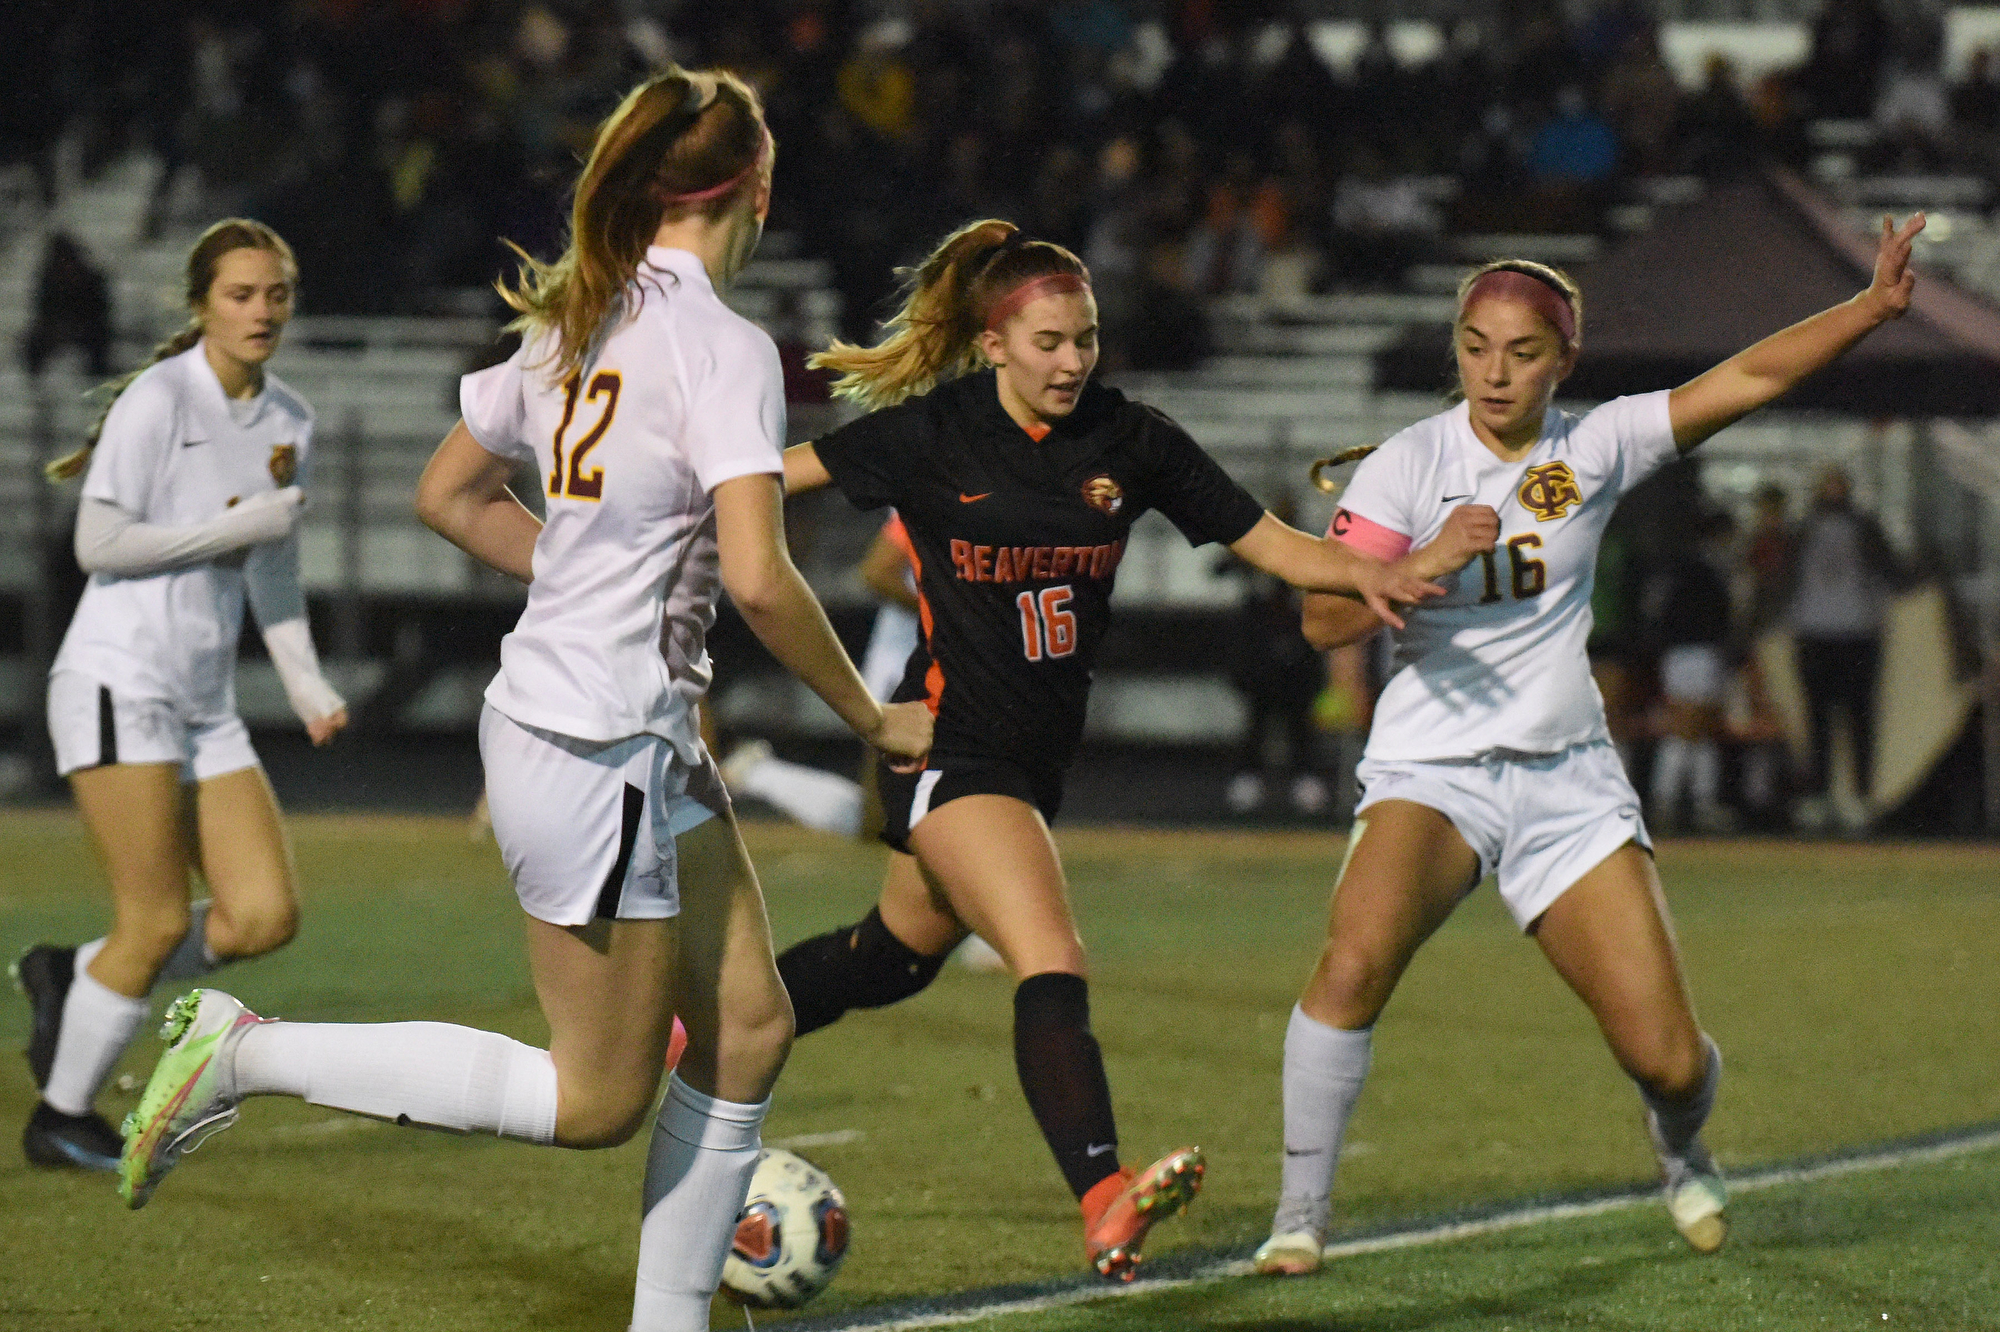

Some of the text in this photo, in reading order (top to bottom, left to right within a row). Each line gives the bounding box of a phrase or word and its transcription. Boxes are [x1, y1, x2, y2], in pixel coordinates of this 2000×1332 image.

[547, 369, 623, 502] 12
[1332, 508, 1353, 537] C
[1480, 531, 1546, 602] 16
[1016, 583, 1077, 663] 16
